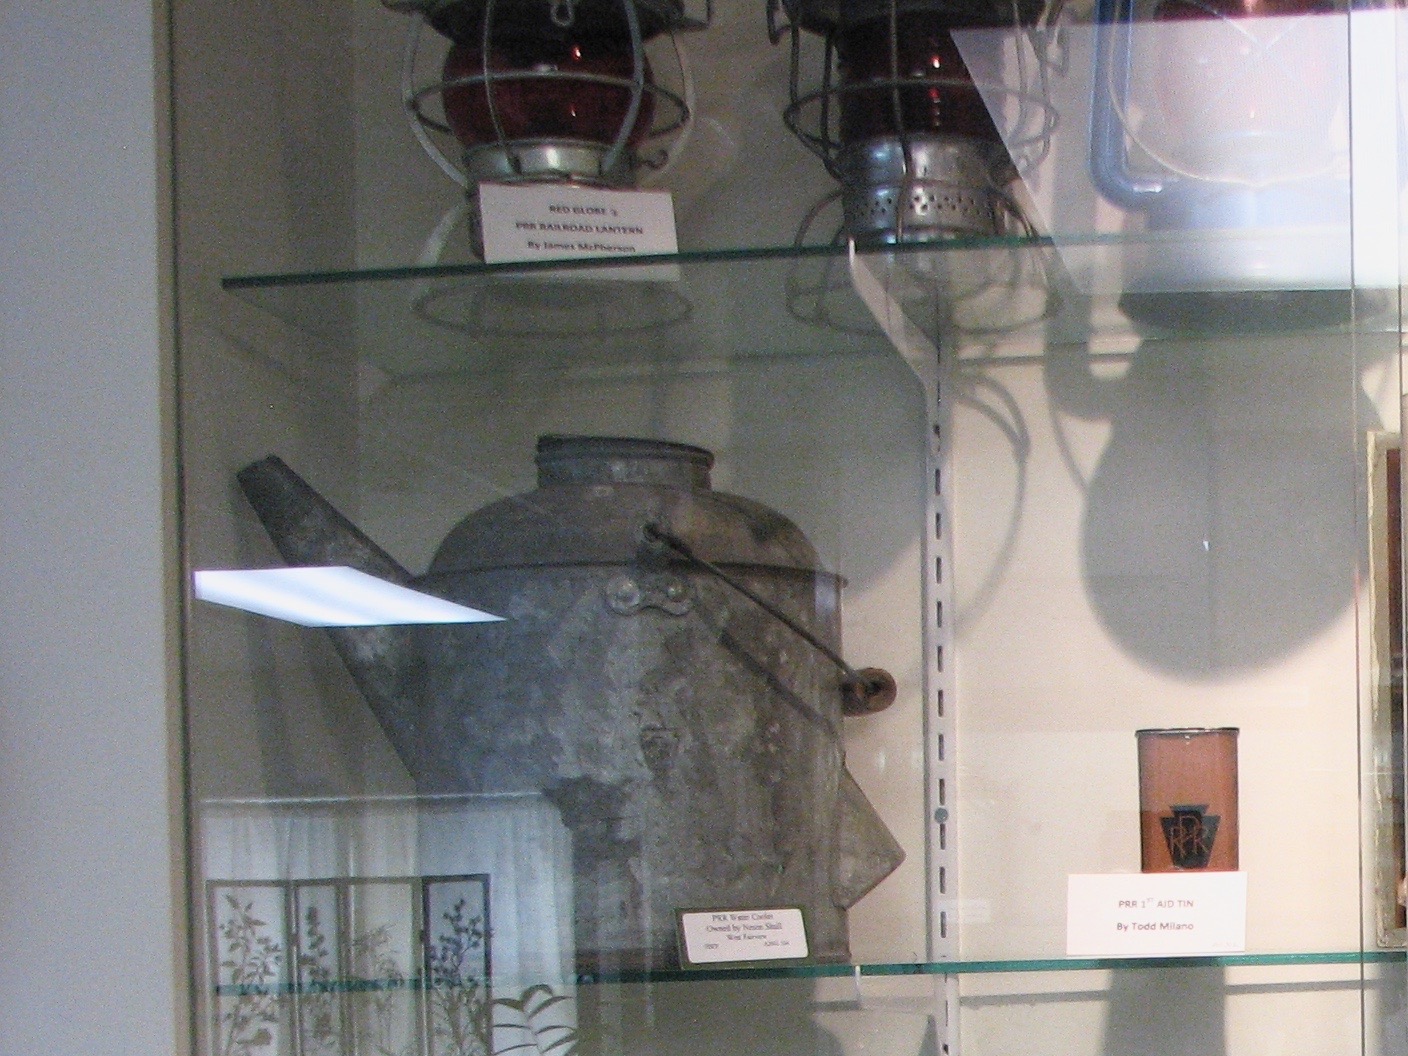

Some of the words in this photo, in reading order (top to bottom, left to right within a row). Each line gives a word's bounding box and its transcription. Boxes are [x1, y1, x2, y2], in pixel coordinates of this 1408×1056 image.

[549, 204, 570, 214] RED
[539, 222, 594, 234] RAILROAD
[595, 224, 645, 235] LANTERN
[527, 240, 541, 251] By
[543, 241, 576, 251] James
[1118, 900, 1137, 909] PRR
[1156, 900, 1174, 909] AID
[1176, 900, 1194, 909] TIN
[732, 924, 741, 932] by
[1116, 922, 1129, 932] By
[1131, 922, 1157, 931] Todd
[1159, 922, 1194, 931] Milano
